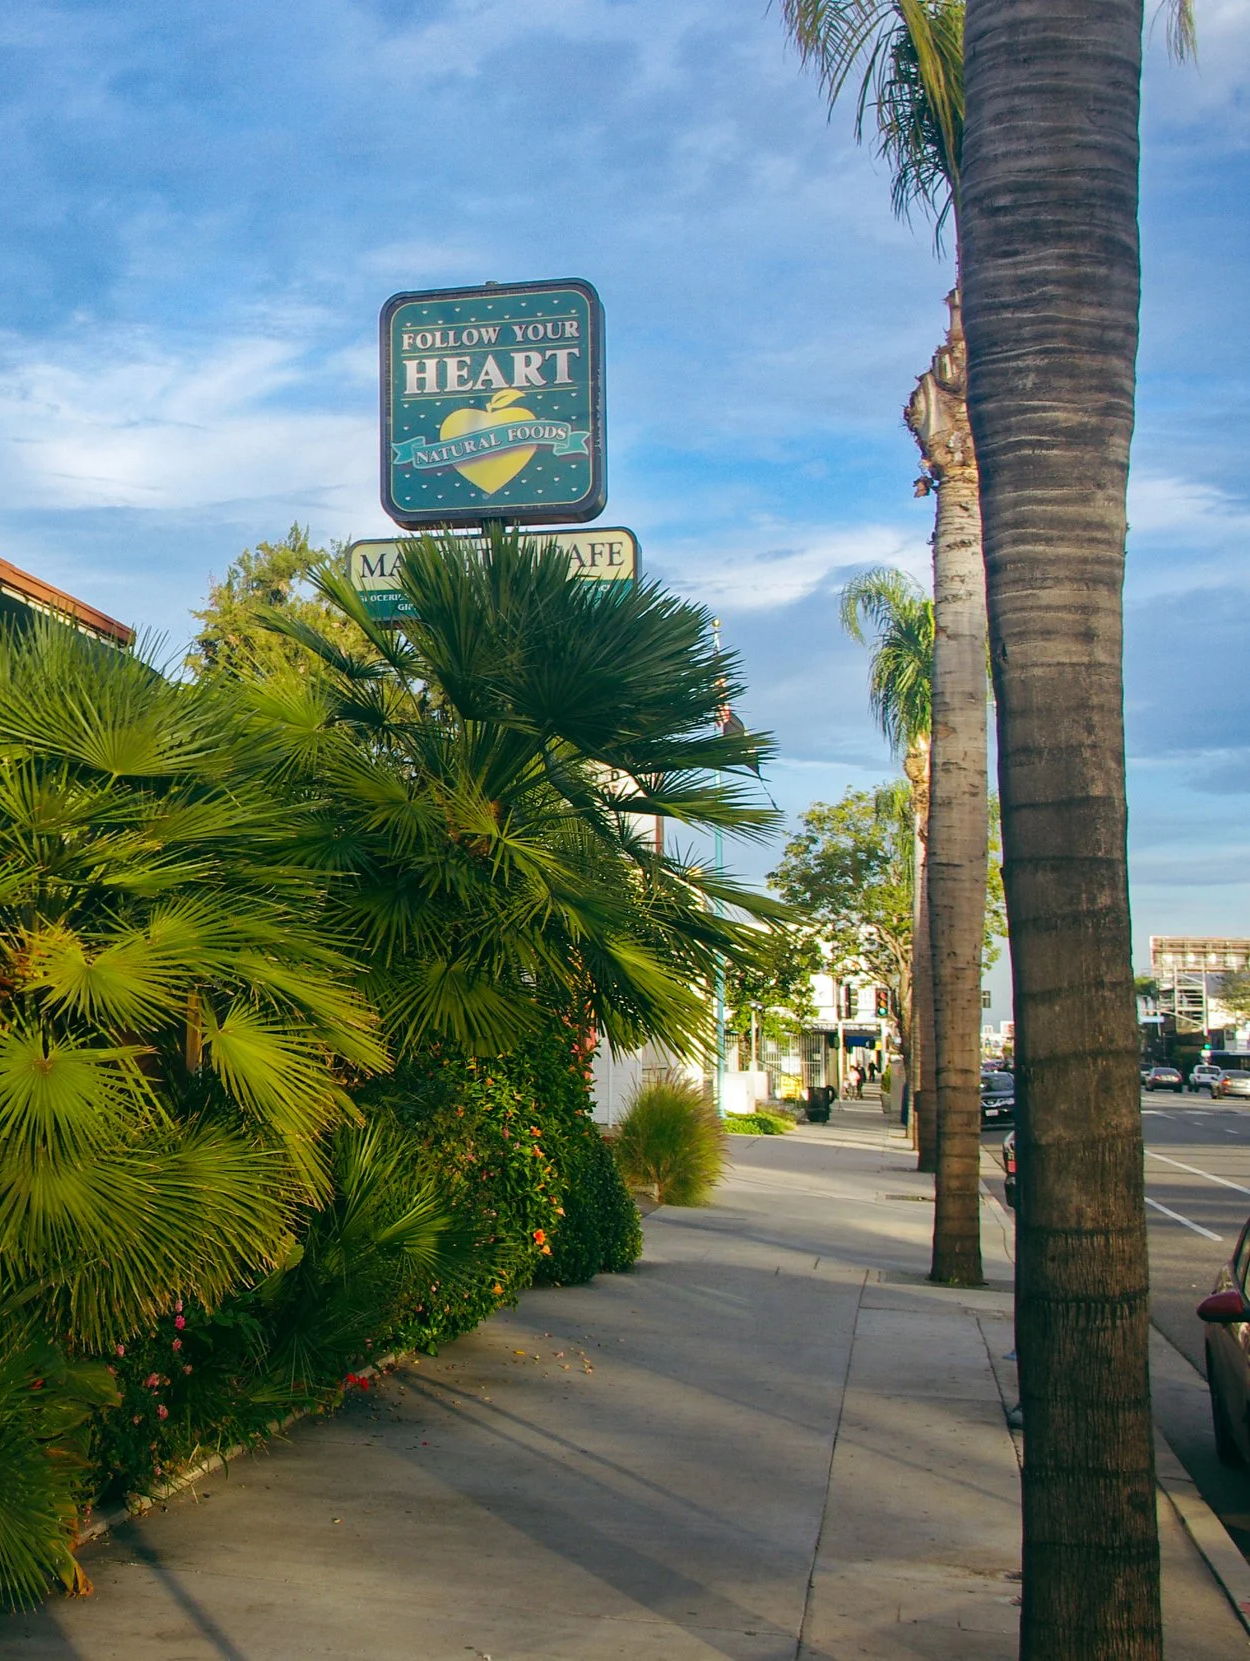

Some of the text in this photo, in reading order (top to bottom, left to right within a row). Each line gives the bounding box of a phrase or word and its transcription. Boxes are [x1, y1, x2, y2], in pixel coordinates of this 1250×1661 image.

[402, 320, 580, 350] FOLLOW YOUR
[403, 348, 580, 395] HEART
[416, 425, 568, 465] NATURAL FOODS
[551, 541, 625, 569] AFE
